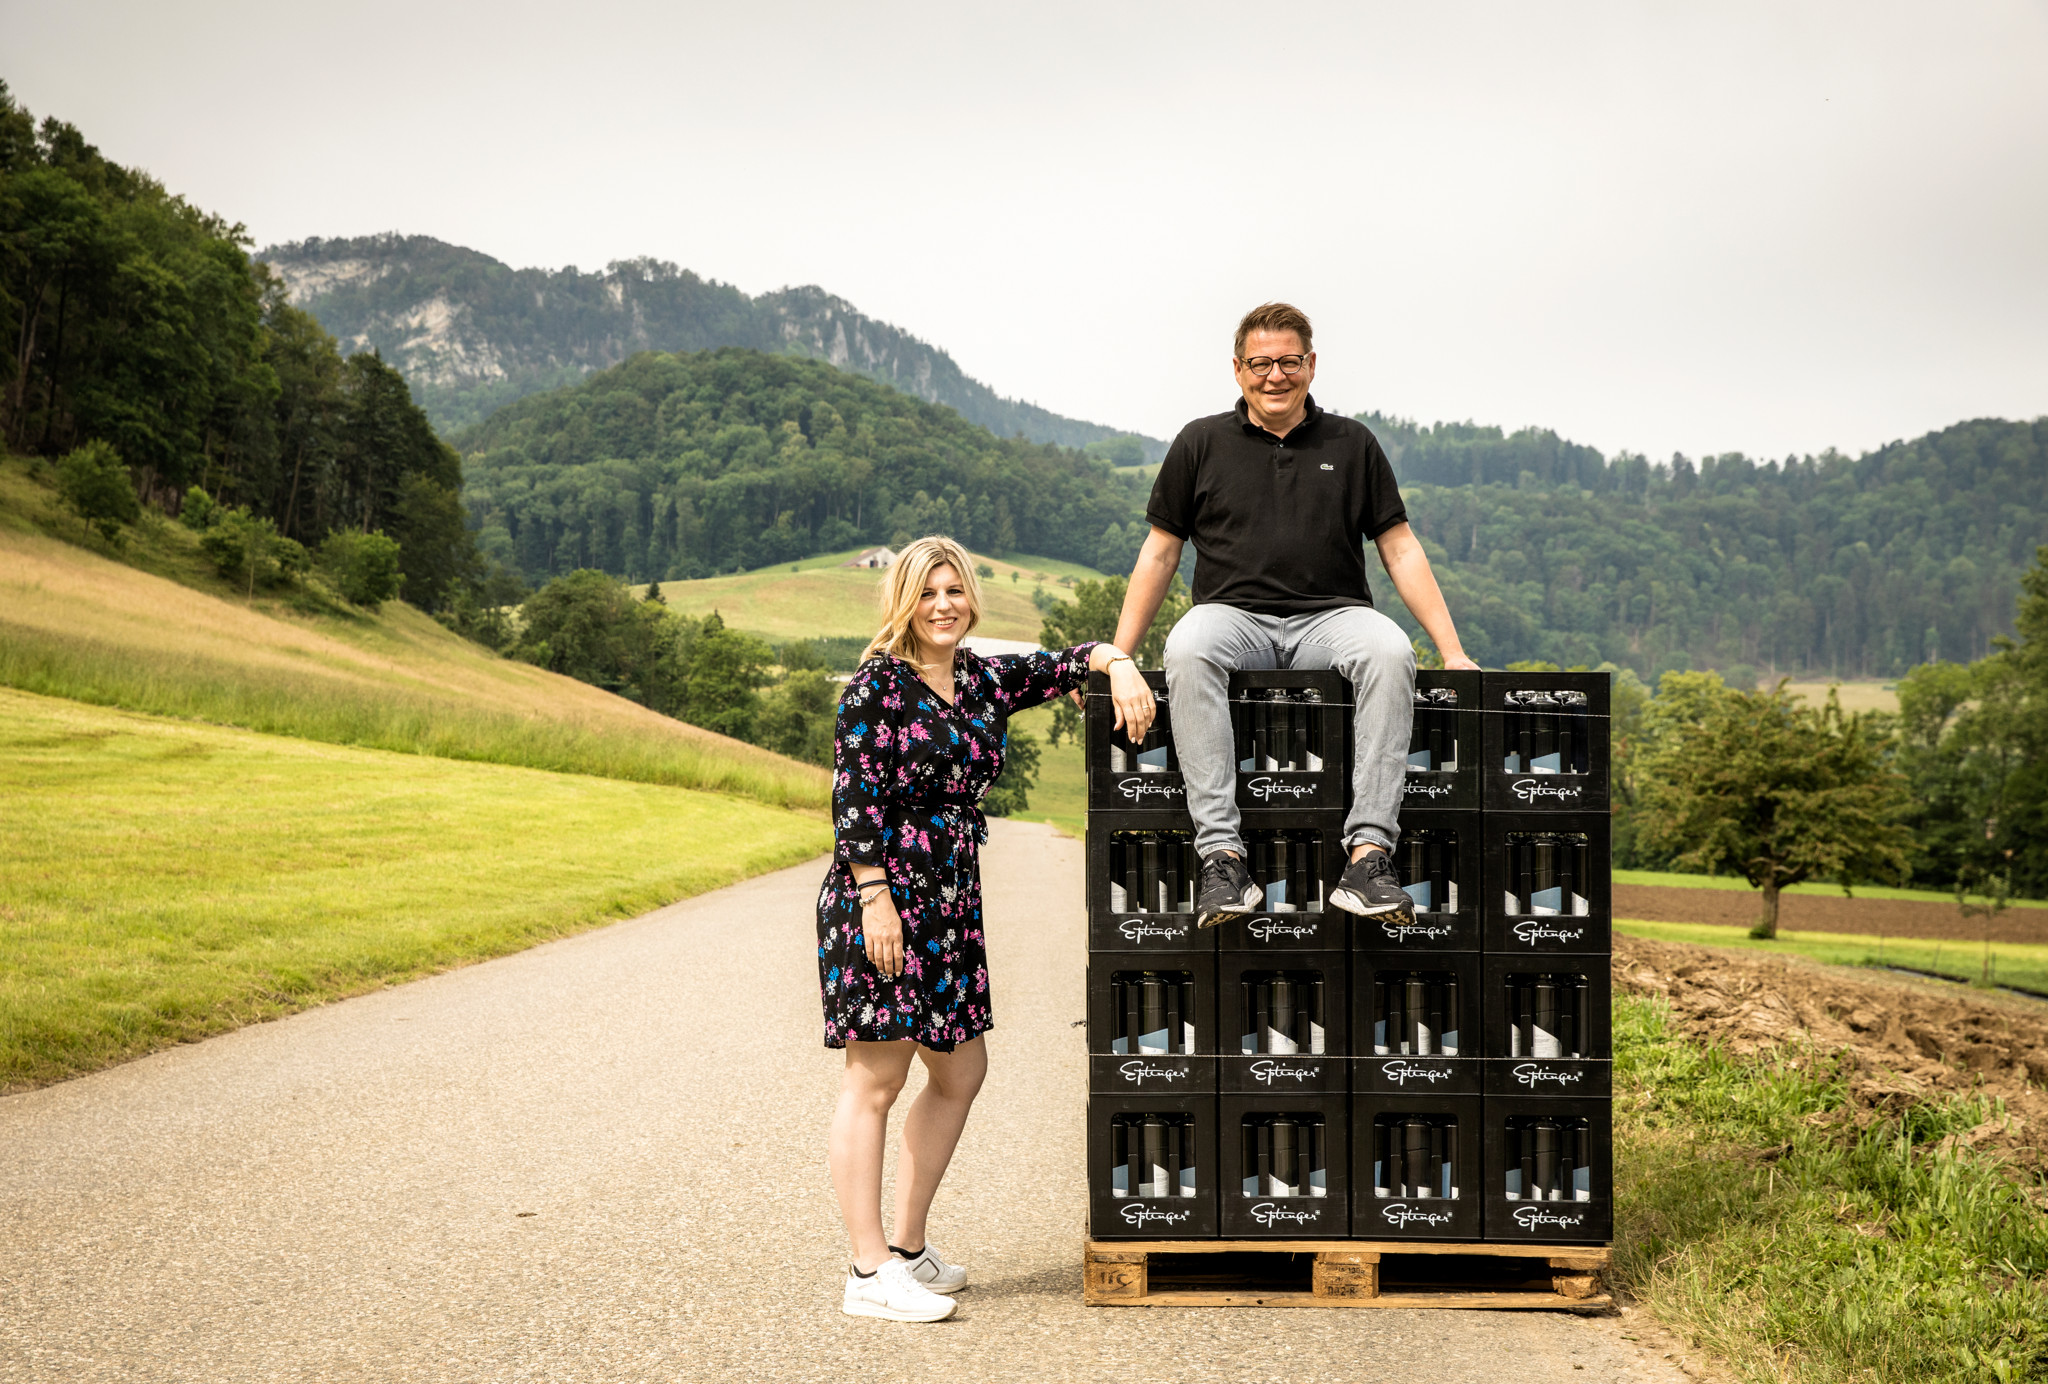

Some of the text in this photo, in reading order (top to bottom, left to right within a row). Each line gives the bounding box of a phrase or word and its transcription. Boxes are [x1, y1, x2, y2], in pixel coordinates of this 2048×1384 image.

[1118, 777, 1184, 802] Eptinger
[1248, 776, 1314, 801] Eptinger
[1401, 778, 1449, 801] ptinger
[1512, 778, 1579, 804] Eptinger
[1119, 918, 1184, 944] Eptinger
[1248, 917, 1314, 943] Eptinger
[1513, 920, 1580, 946] Eptinger
[1119, 1060, 1186, 1086] Eptinger
[1250, 1060, 1316, 1085] Eptinger
[1382, 1060, 1449, 1086] Eptinger
[1513, 1063, 1580, 1089] Eptinger
[1120, 1203, 1187, 1229] Eptinger
[1250, 1203, 1317, 1228] Eptinger
[1382, 1203, 1449, 1229] Eptinger
[1513, 1206, 1580, 1232] Eptinger
